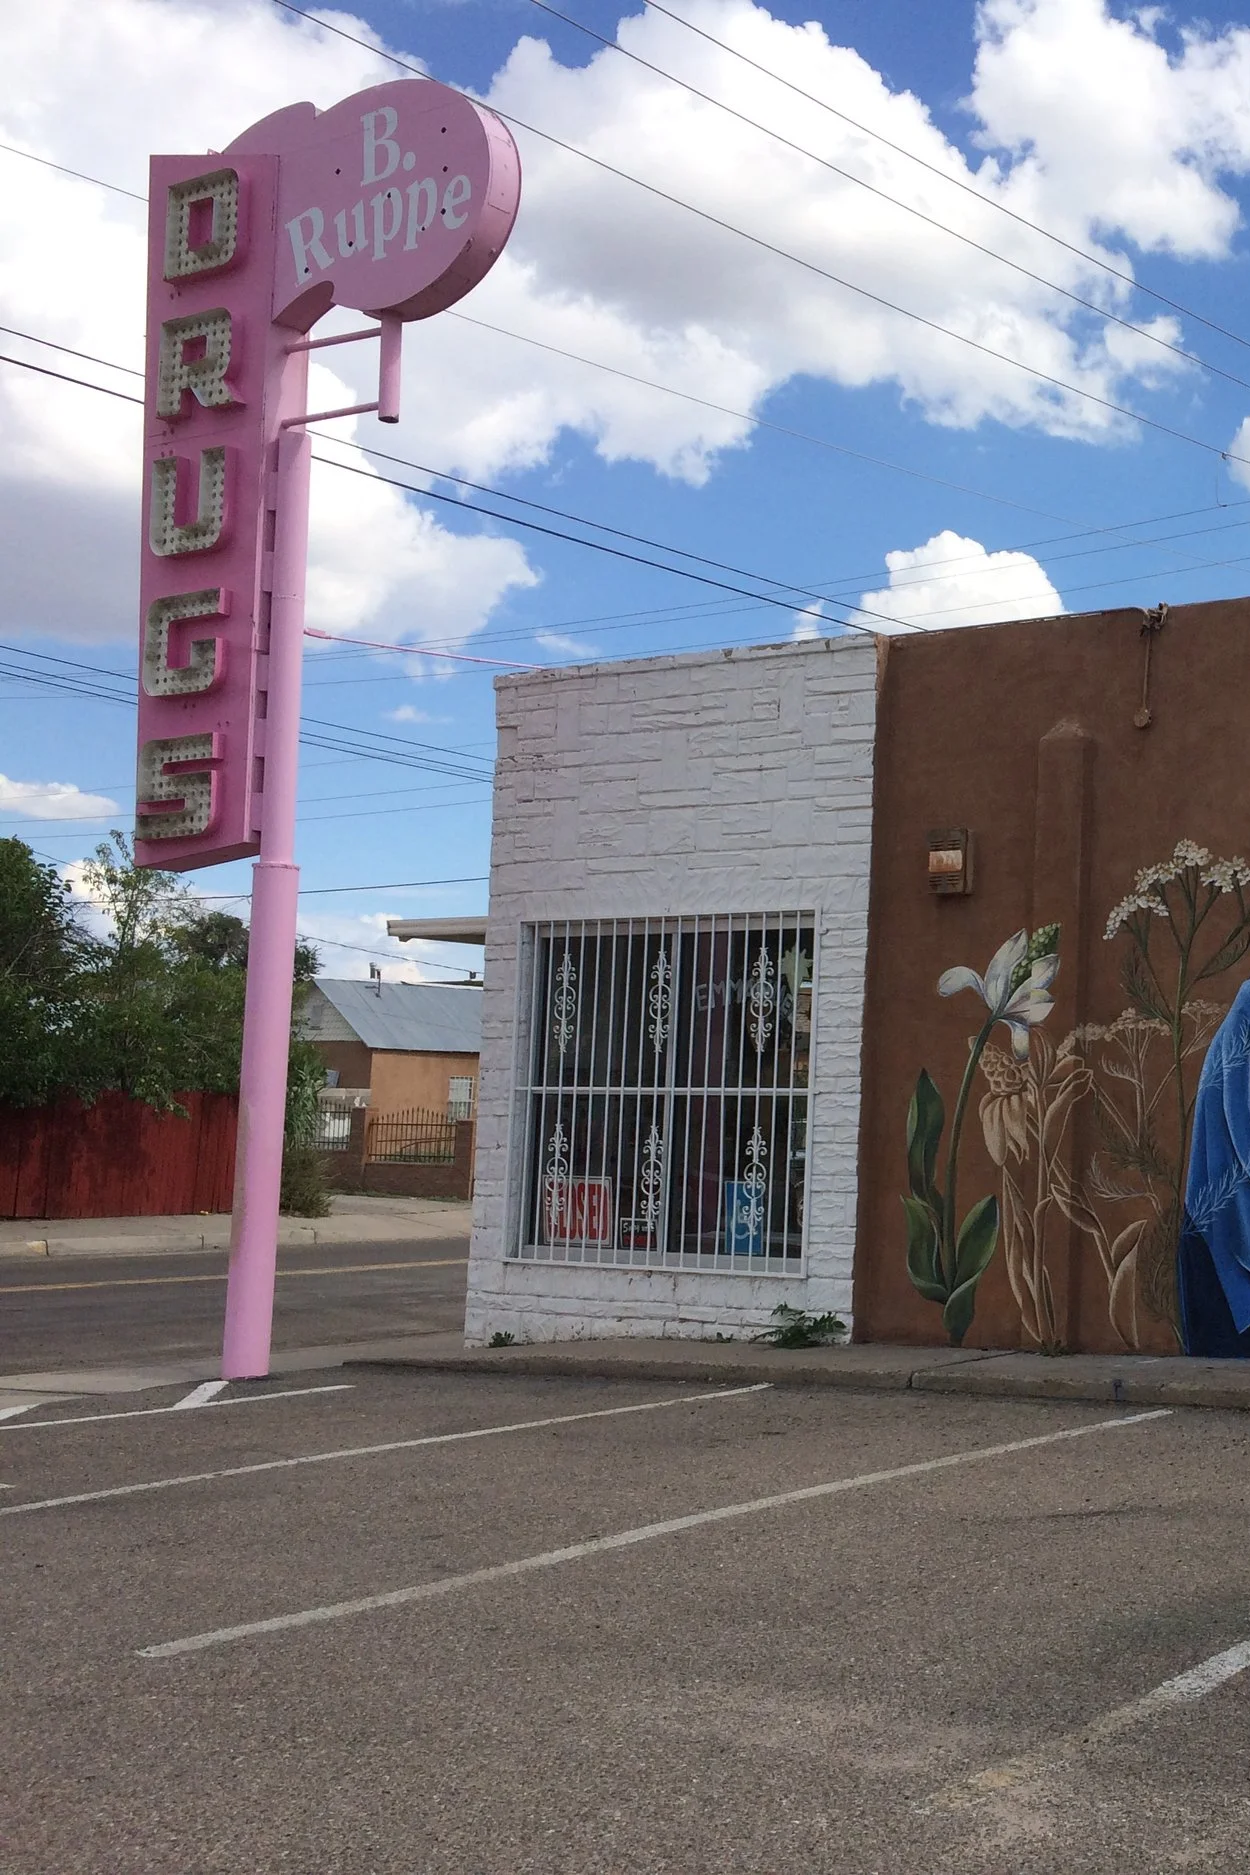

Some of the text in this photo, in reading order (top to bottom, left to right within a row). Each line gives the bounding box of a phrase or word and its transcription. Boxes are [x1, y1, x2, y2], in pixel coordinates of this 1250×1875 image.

[359, 106, 417, 188] B.
[285, 173, 472, 288] Ruppe
[135, 168, 240, 841] DRUGS
